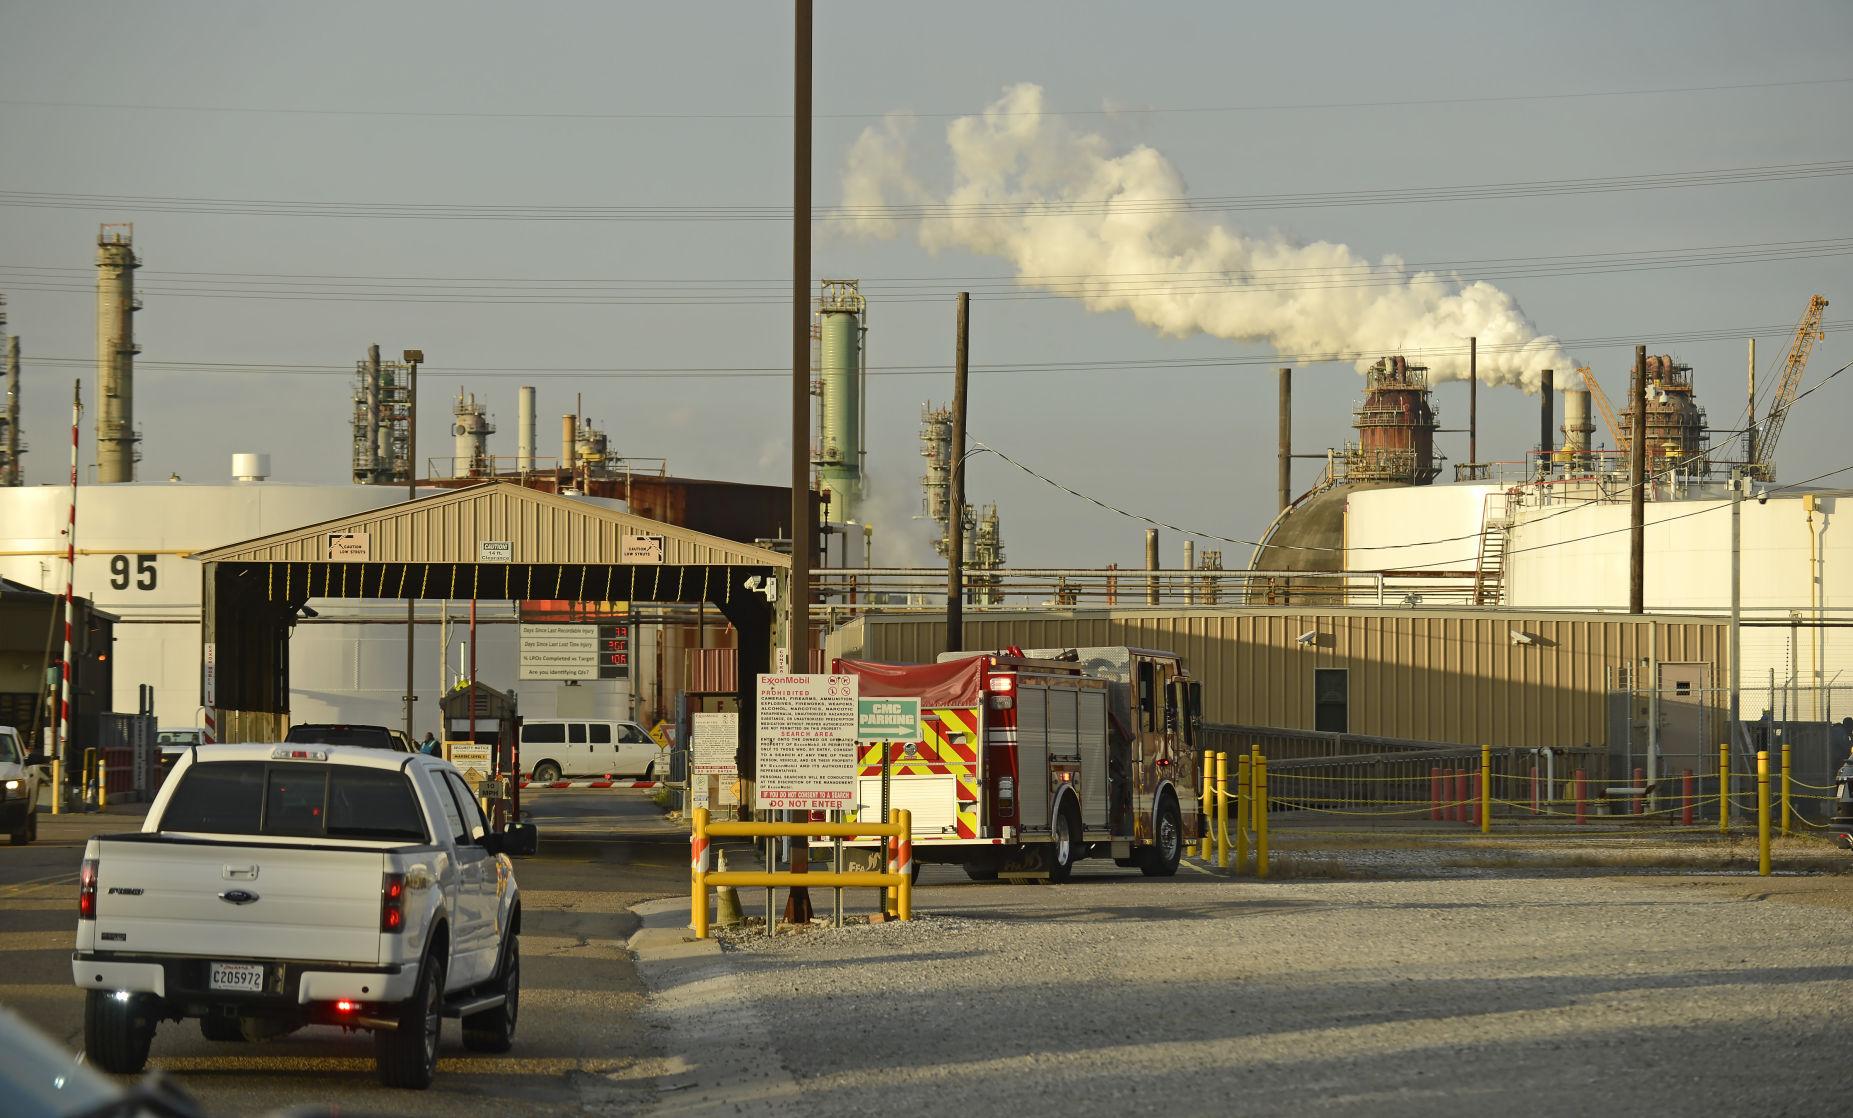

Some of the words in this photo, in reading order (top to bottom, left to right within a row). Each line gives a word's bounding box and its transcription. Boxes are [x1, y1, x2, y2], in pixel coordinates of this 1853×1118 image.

[110, 554, 157, 591] 95
[761, 676, 810, 686] ExxonMobil
[860, 714, 915, 725] PARKING
[770, 800, 784, 808] DO
[789, 800, 807, 808] NOT
[214, 971, 261, 985] C205972
